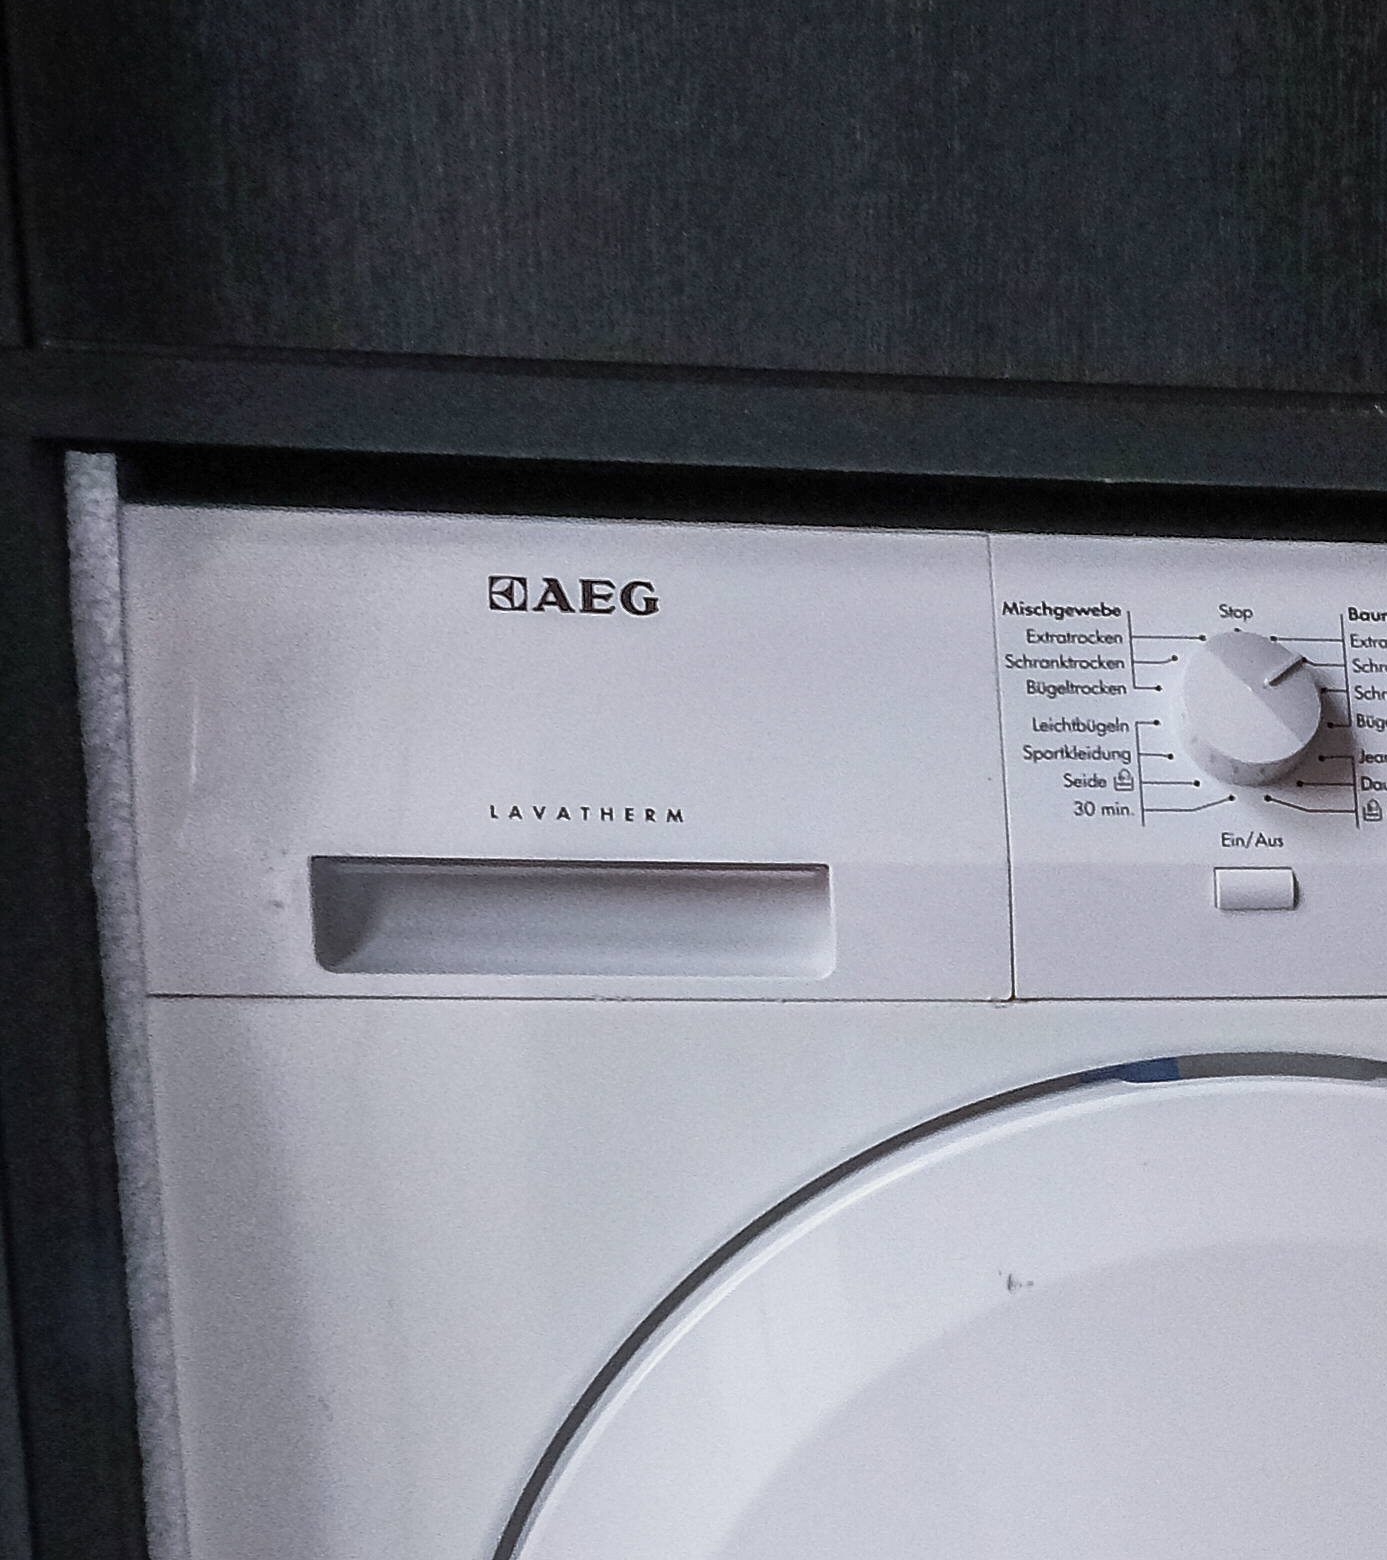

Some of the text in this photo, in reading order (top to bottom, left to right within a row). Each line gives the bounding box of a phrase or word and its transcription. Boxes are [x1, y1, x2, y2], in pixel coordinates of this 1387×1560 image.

[533, 577, 660, 616] AEG
[1002, 602, 1122, 621] Mischgewebe
[1218, 604, 1254, 624] Stop
[1026, 629, 1123, 646] Extratrocken
[1004, 654, 1125, 671] Schranktrocken
[1026, 680, 1127, 697] Bügeltrocken
[1032, 717, 1130, 736] Leichtbügeln
[1022, 745, 1131, 765] Sportkleidung
[1063, 774, 1107, 790] Seide
[490, 803, 687, 824] LAVATHERM
[1074, 801, 1134, 817] 30 min.
[1221, 831, 1285, 851] Ein/Aus
